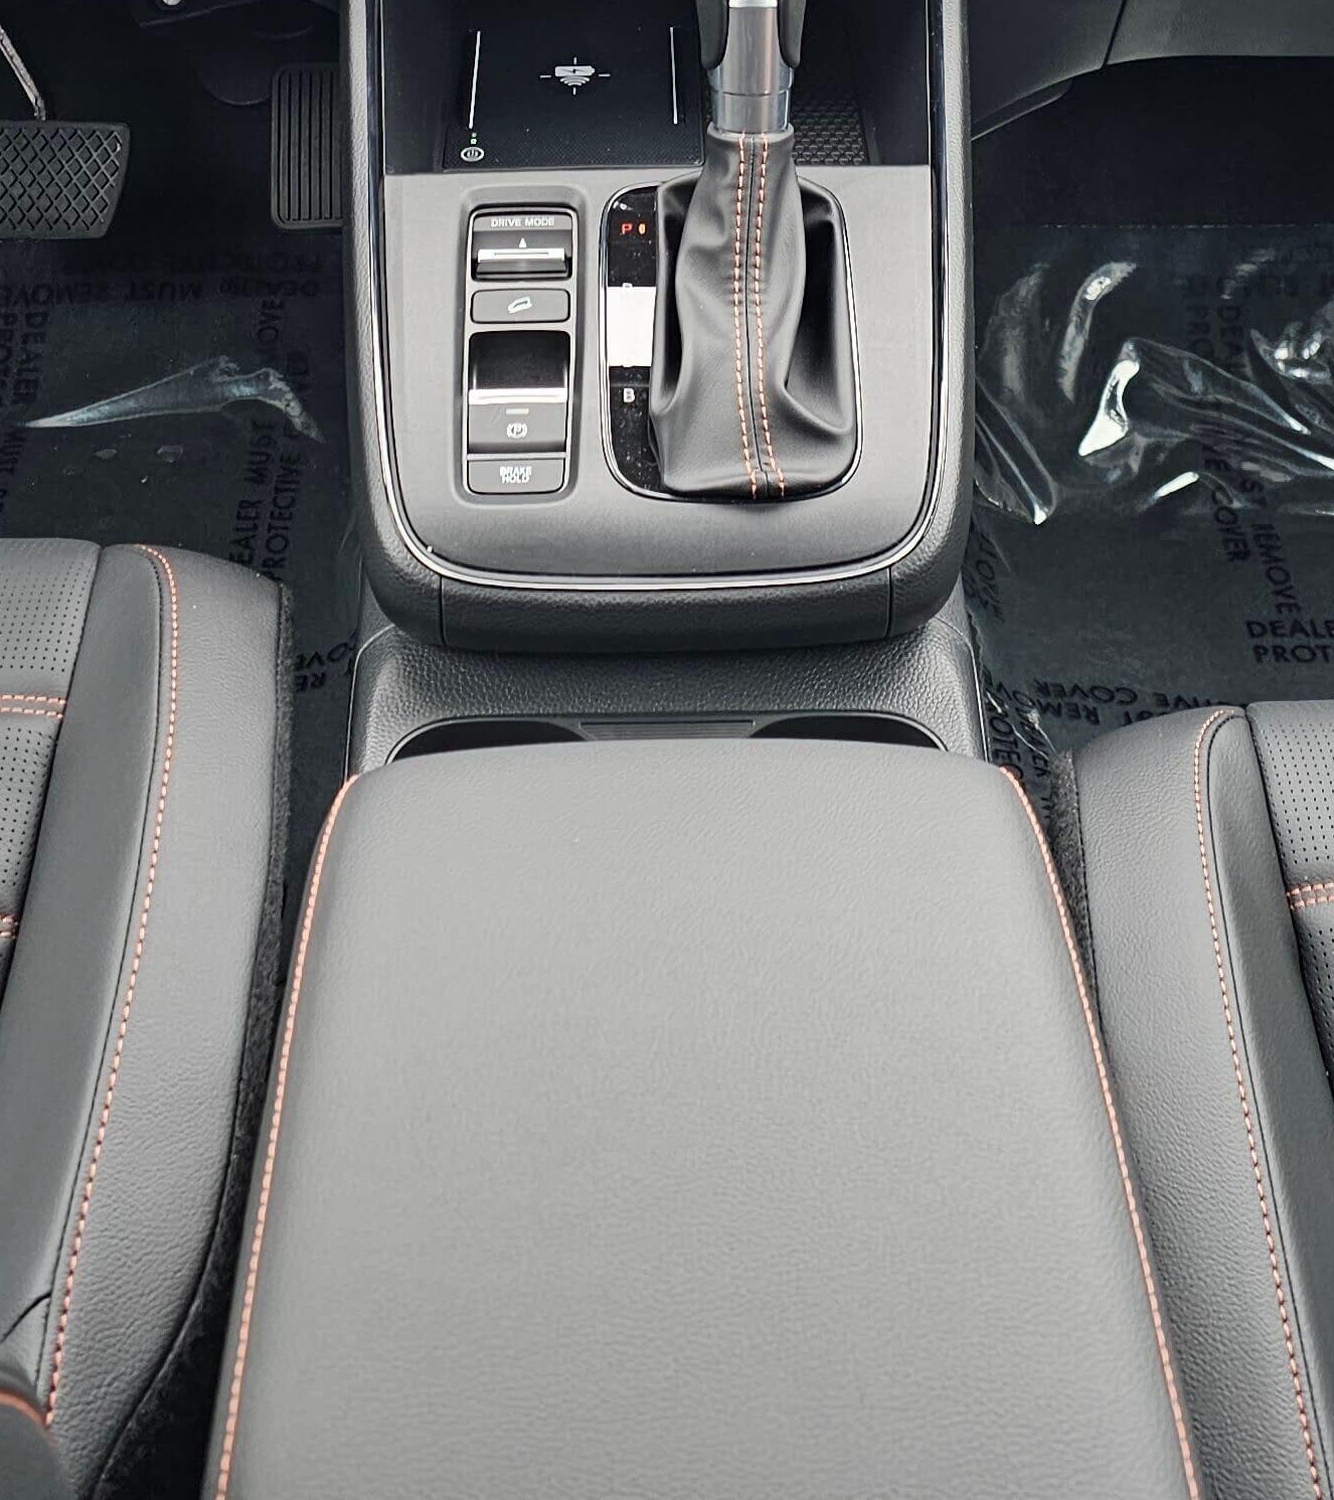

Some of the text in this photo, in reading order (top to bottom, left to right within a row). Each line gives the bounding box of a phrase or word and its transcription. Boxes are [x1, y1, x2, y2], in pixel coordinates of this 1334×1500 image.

[490, 217, 555, 228] DRIVE MODE
[623, 388, 635, 403] B
[499, 466, 532, 477] BRAKE
[501, 474, 530, 484] HOLD
[1033, 678, 1138, 706] COVER
